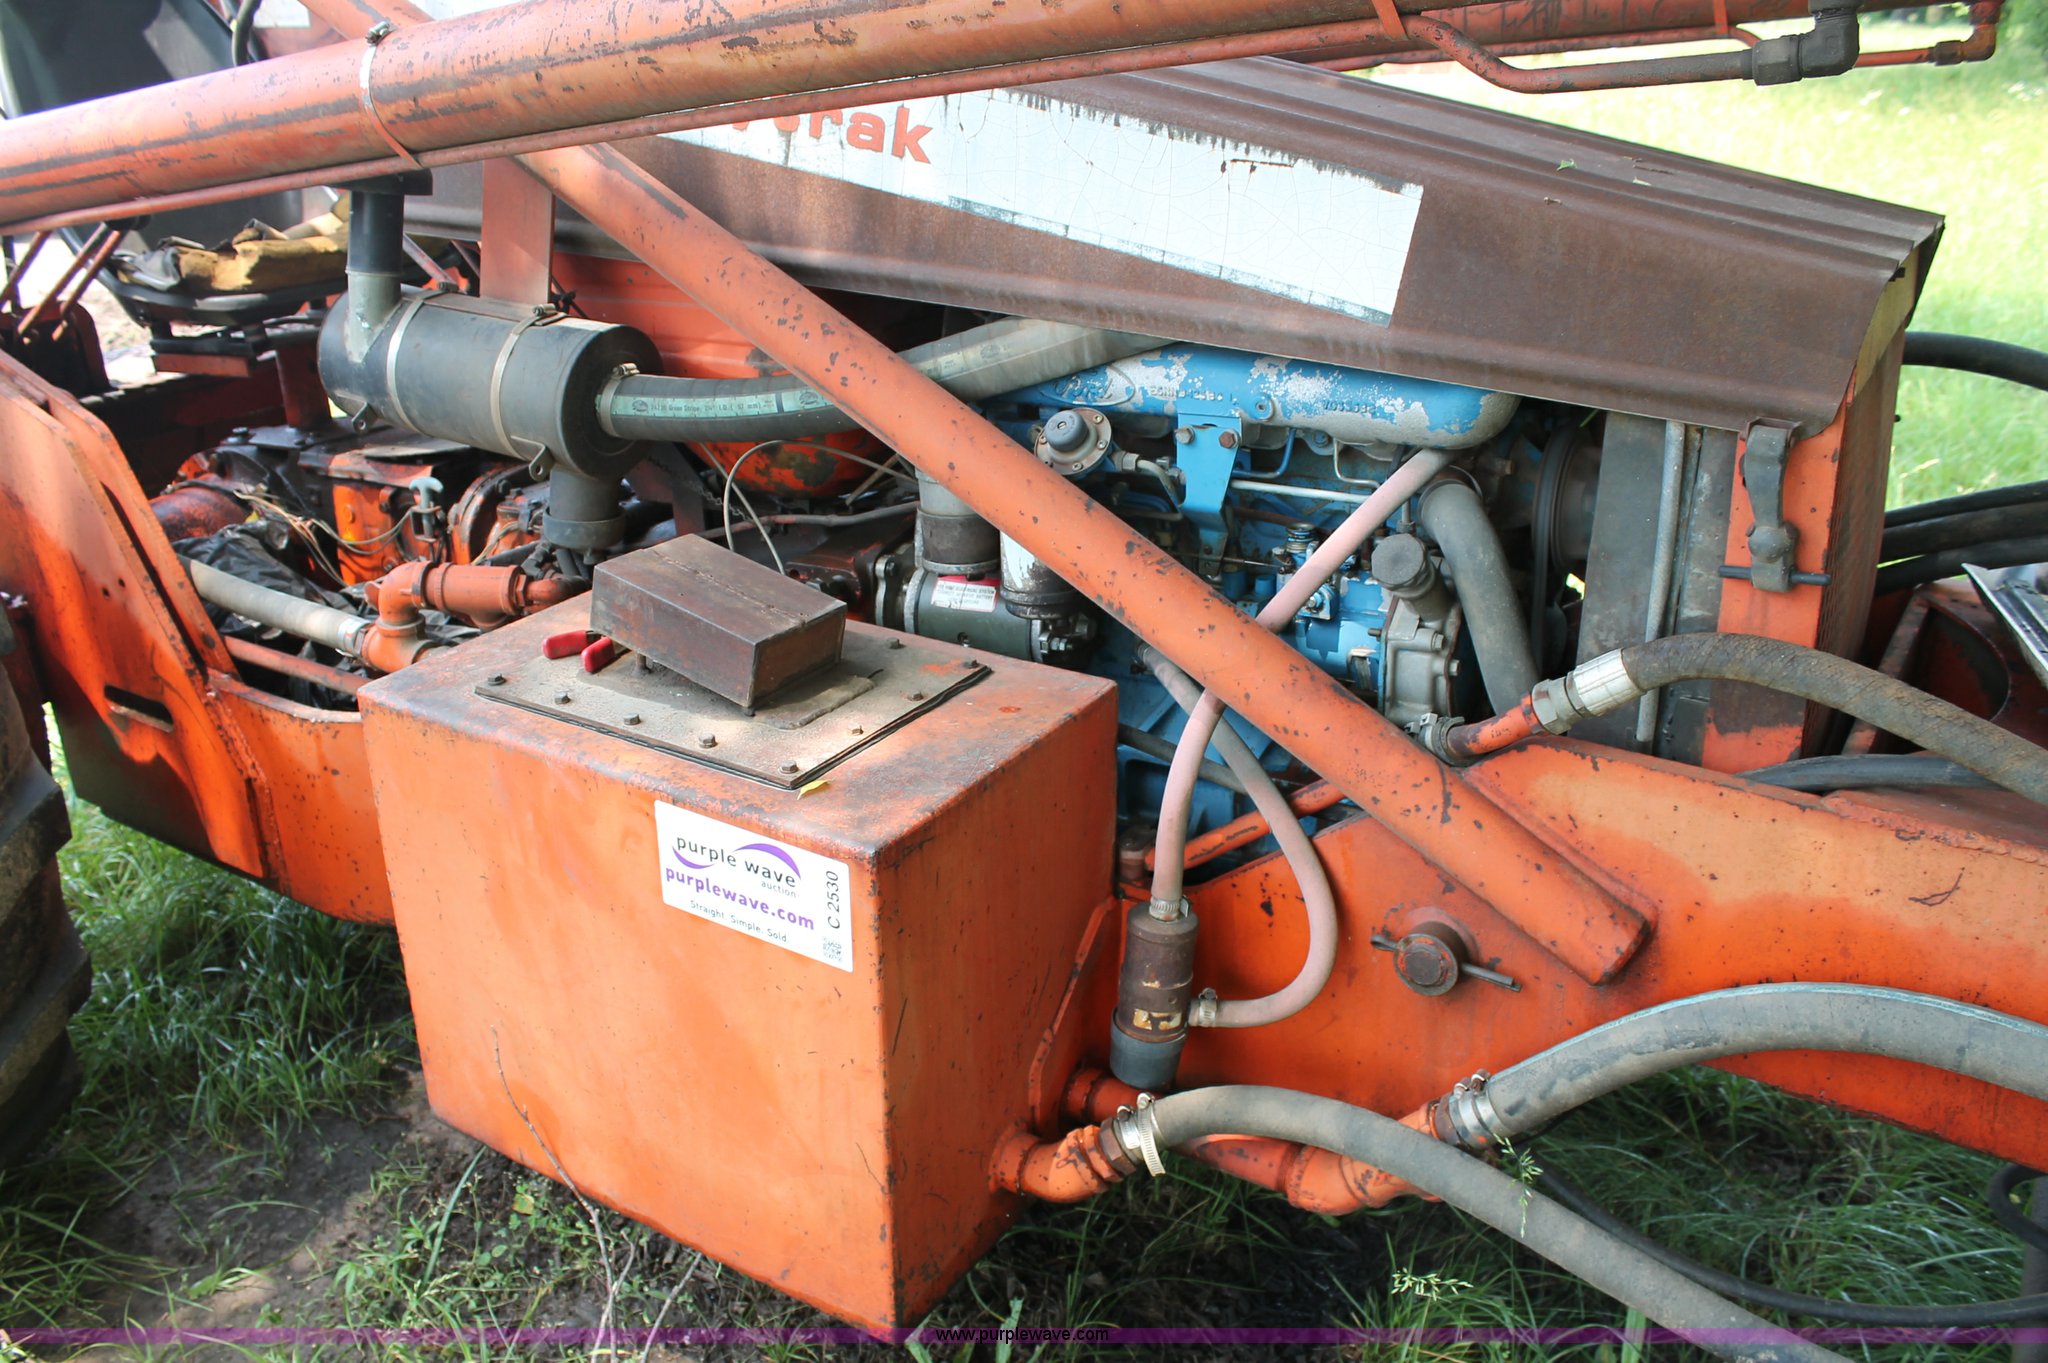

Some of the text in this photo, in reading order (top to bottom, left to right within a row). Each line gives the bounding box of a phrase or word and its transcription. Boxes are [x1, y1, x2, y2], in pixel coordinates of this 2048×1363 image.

[677, 836, 796, 888] purple wave
[665, 867, 815, 931] purplewave.com
[761, 880, 797, 898] auction
